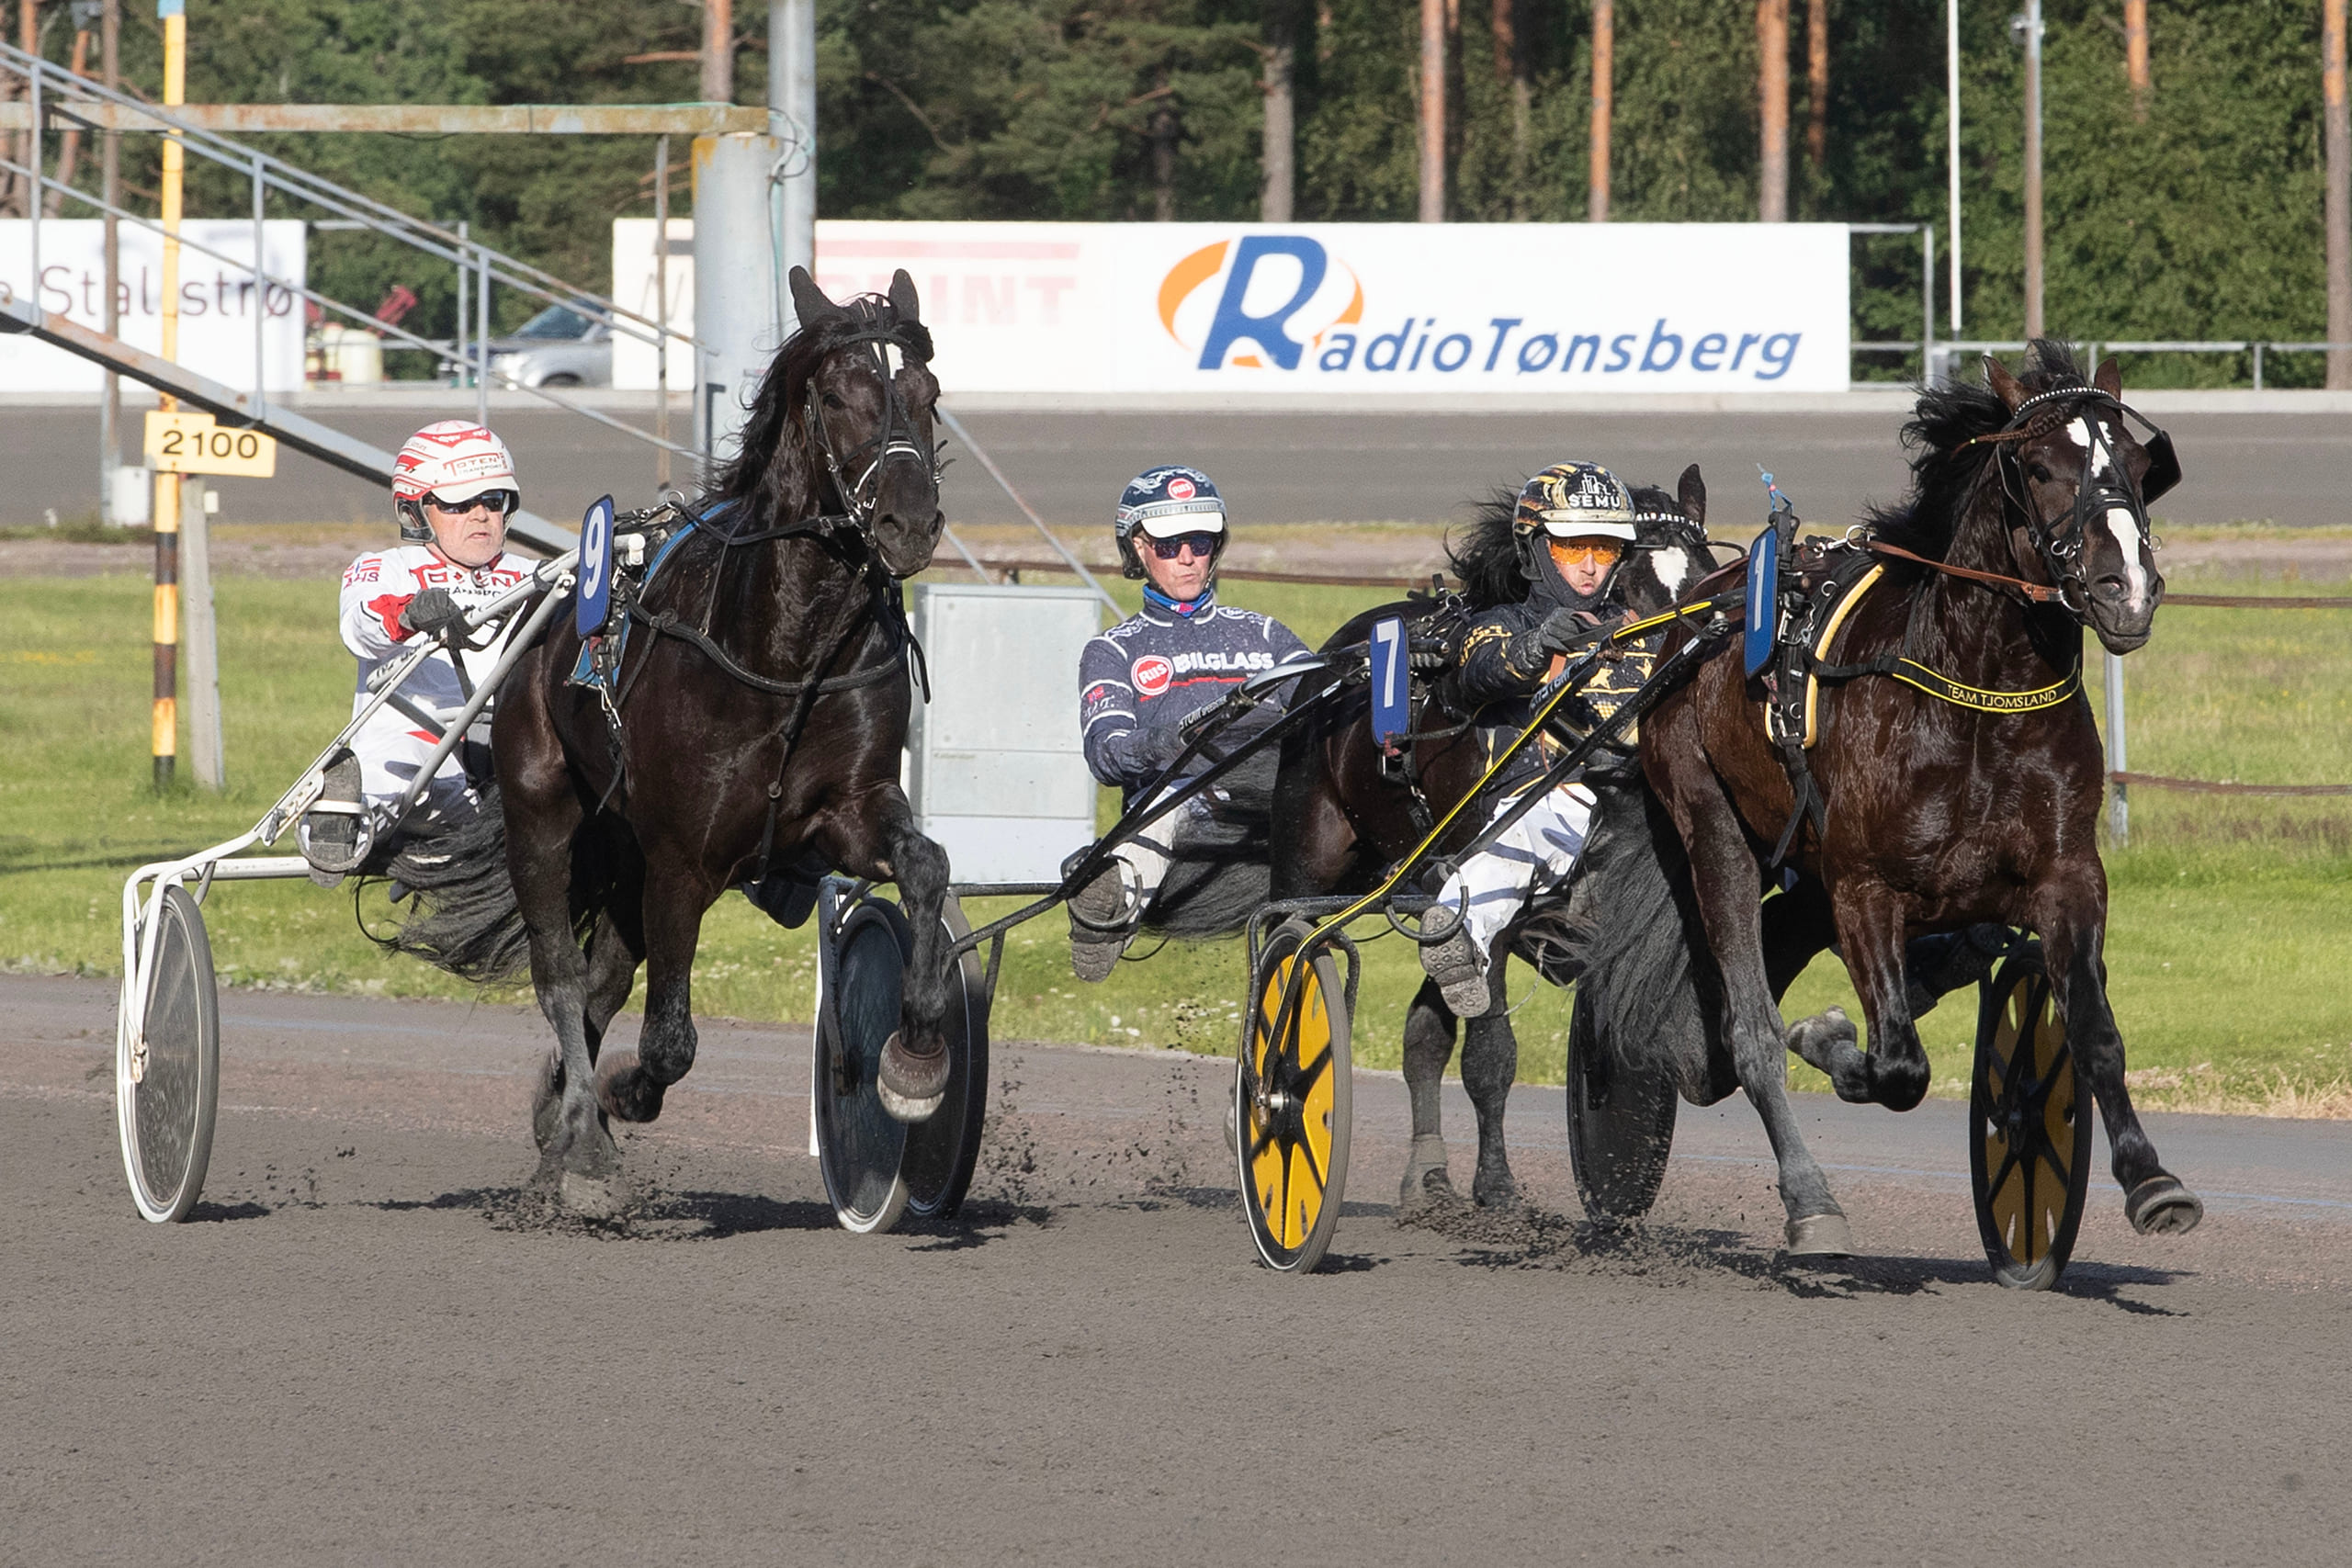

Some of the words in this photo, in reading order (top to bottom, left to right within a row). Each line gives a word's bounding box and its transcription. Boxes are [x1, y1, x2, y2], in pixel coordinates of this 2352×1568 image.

[40, 265, 293, 318] Stalstrø
[163, 429, 259, 458] 2100
[443, 452, 501, 477] TOTEN
[1567, 493, 1622, 509] SEMU
[582, 505, 606, 600] 9
[1754, 536, 1768, 632] 1
[1138, 663, 1168, 685] RIIS
[1171, 651, 1275, 673] BILGLASS
[1376, 619, 1400, 708] 7
[1948, 683, 1978, 705] TEAM
[1980, 689, 2057, 709] TJOMSLAND
